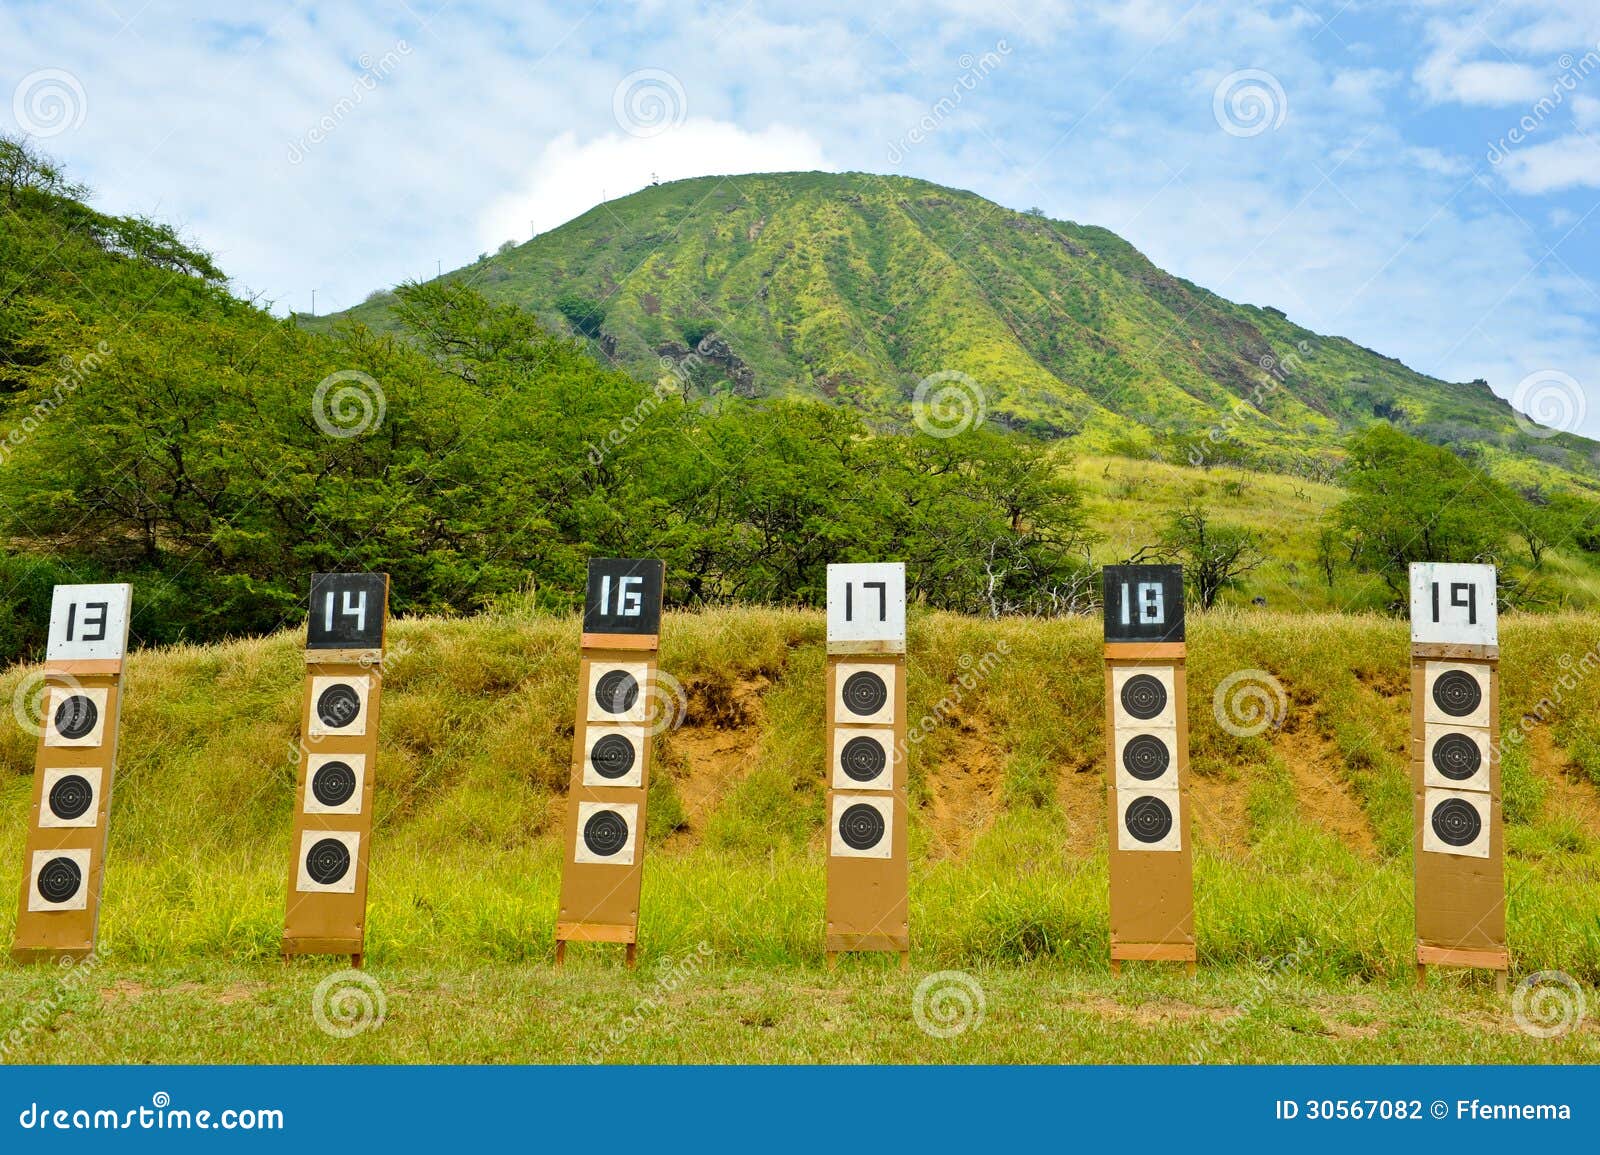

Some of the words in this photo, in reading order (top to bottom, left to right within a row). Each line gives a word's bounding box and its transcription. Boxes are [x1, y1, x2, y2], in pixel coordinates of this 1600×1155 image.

[325, 591, 367, 632] 14
[600, 575, 643, 616] 16
[846, 582, 886, 622] 17
[1121, 582, 1165, 625] 18
[1432, 582, 1477, 625] 19
[66, 602, 108, 641] 13
